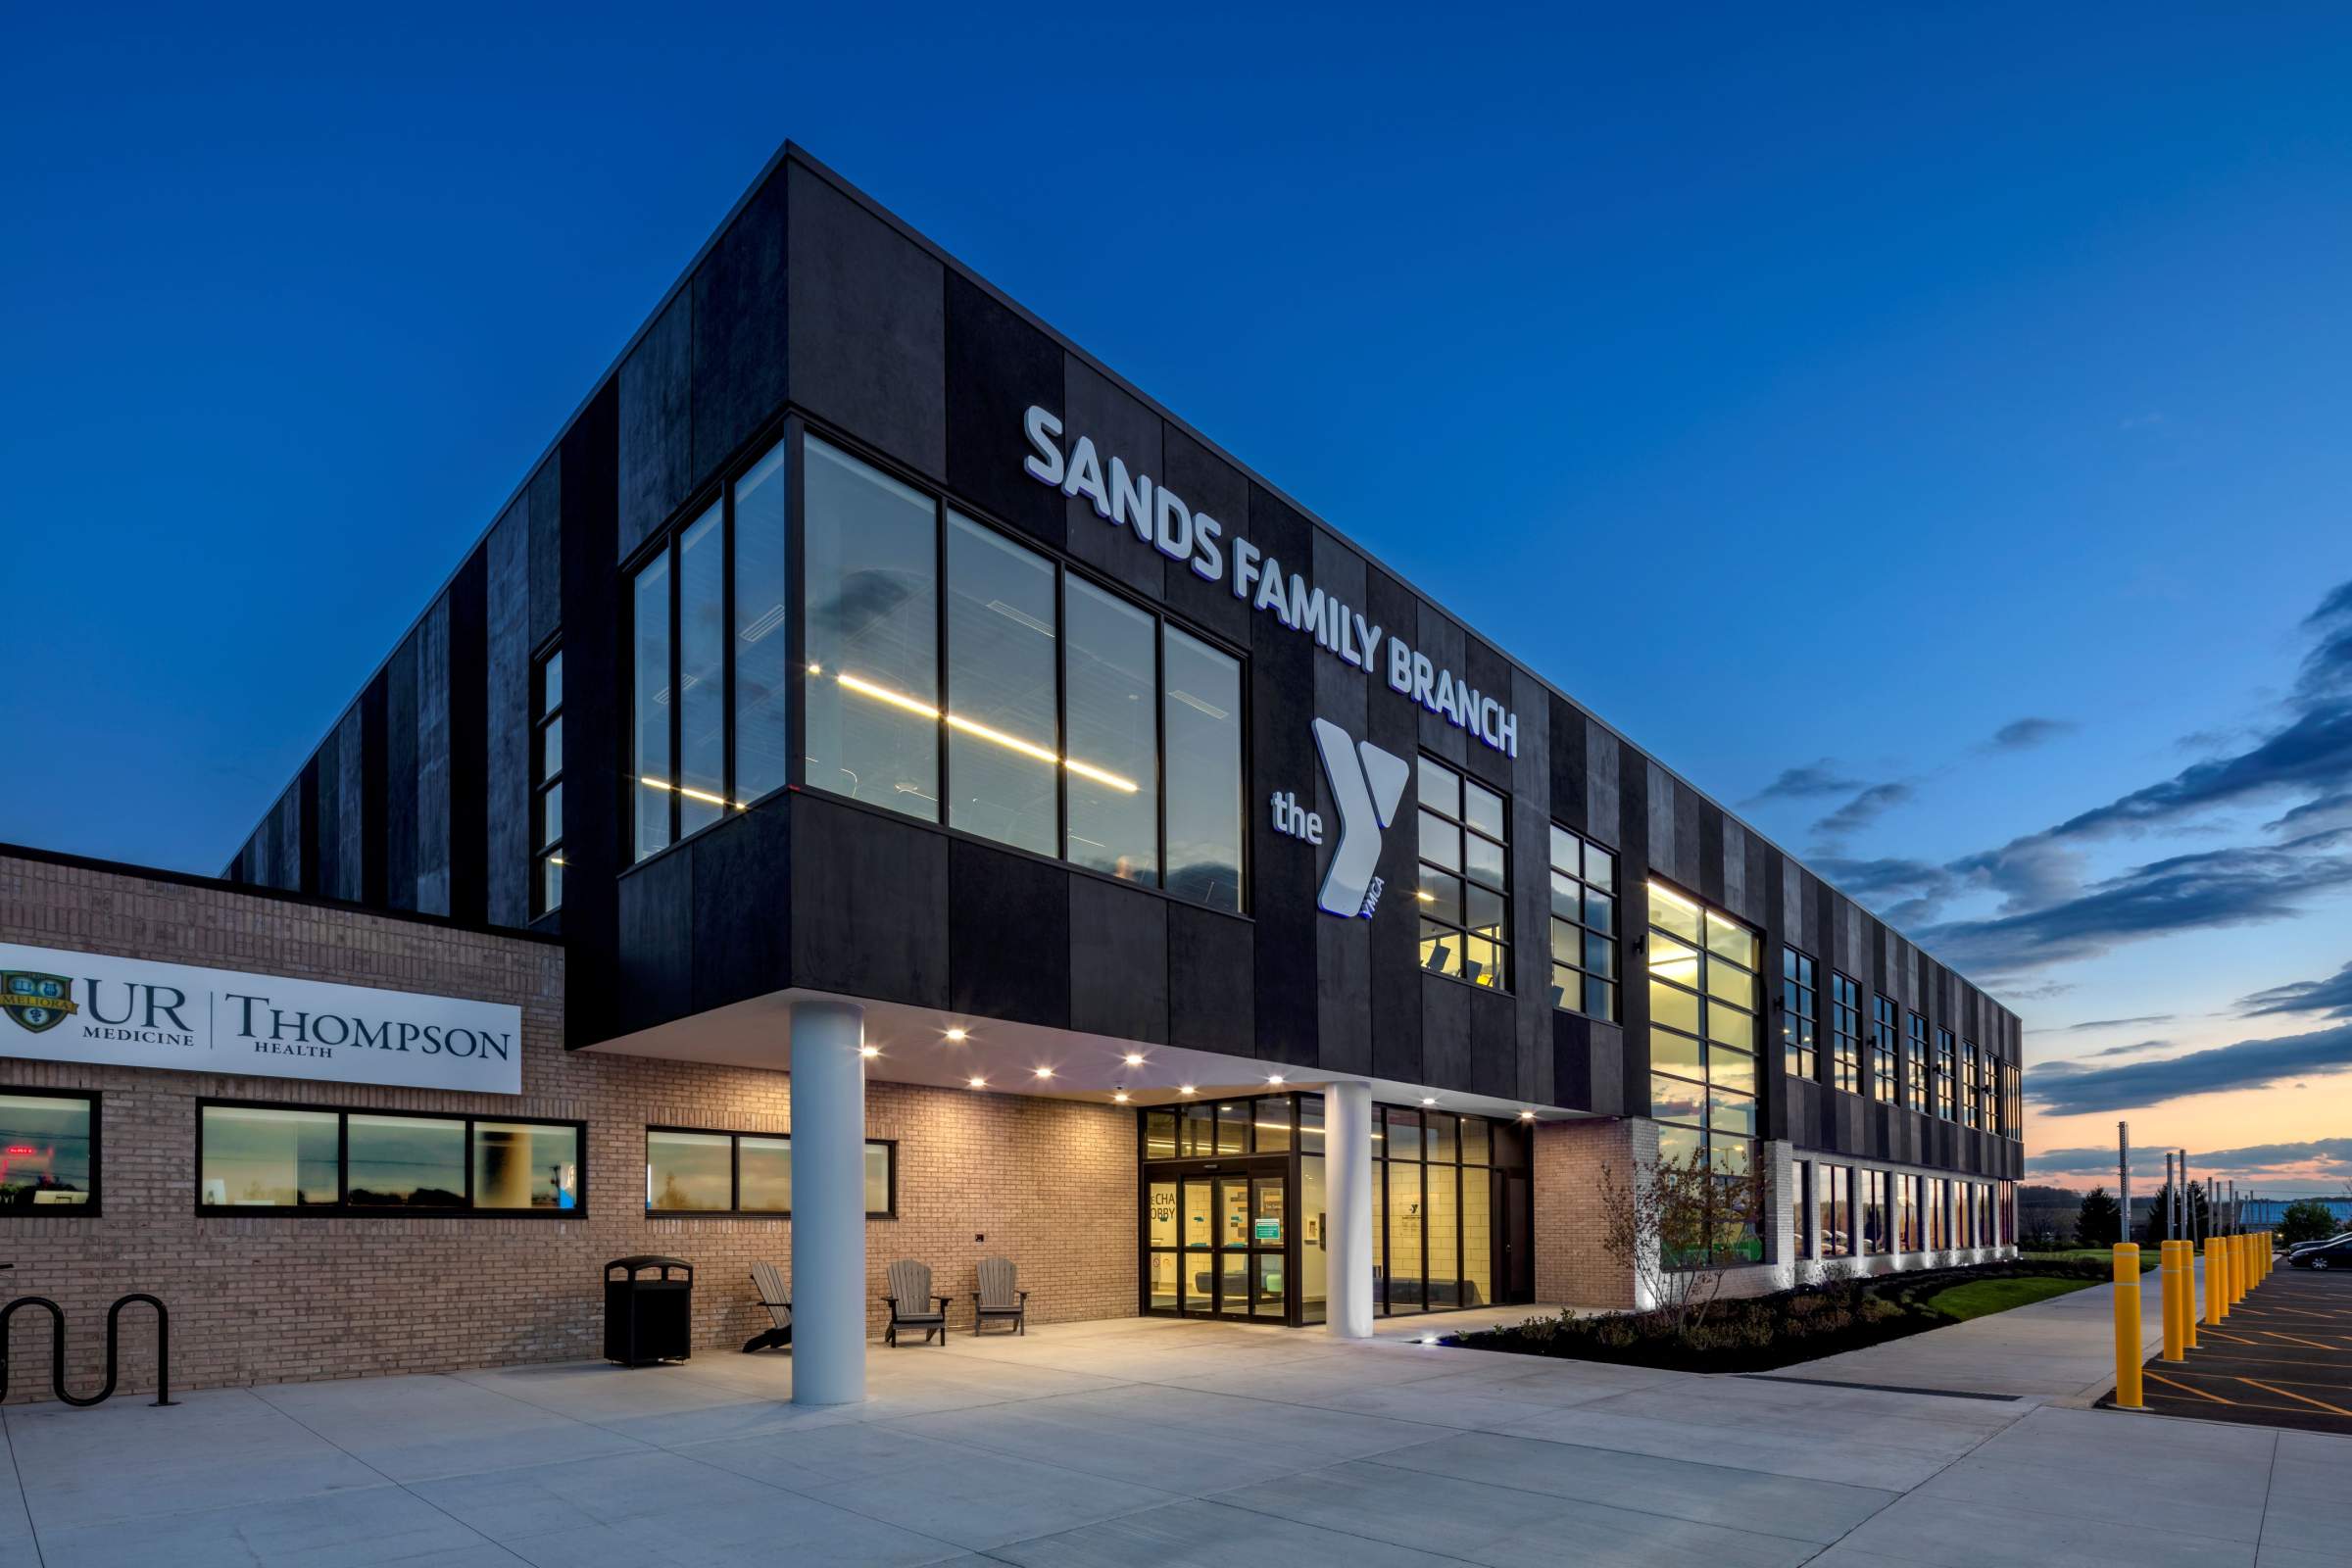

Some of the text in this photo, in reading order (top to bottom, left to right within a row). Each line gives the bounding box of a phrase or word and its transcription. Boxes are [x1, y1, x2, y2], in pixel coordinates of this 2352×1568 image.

[1024, 405, 1518, 759] SANDS FAMILY BRANCH
[1272, 717, 1410, 918] the Y
[1359, 876, 1385, 919] YMCA
[2, 995, 71, 1010] MELIORA
[82, 977, 195, 1032] UR
[82, 1026, 195, 1047] MEDICINE
[224, 993, 512, 1062] THOMPSON
[254, 1041, 333, 1059] HEALTH
[1151, 1206, 1176, 1220] OBBY
